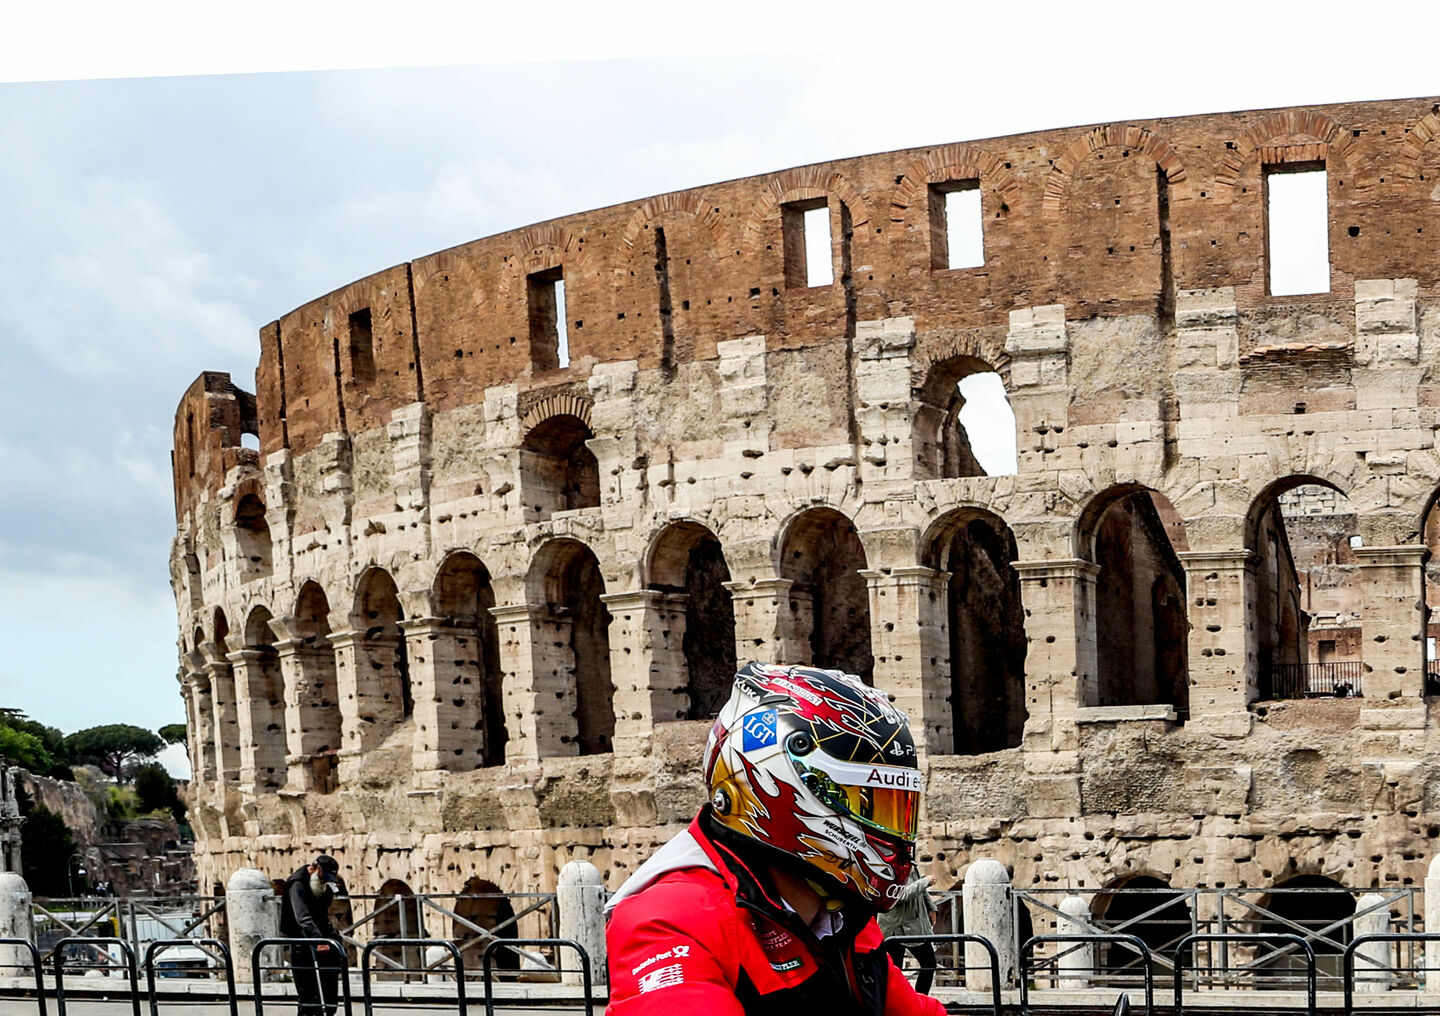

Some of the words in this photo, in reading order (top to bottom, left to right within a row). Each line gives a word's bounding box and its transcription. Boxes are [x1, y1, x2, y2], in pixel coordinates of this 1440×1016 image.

[734, 678, 761, 704] KUKA
[743, 716, 775, 744] LGT
[866, 768, 909, 787] Audi
